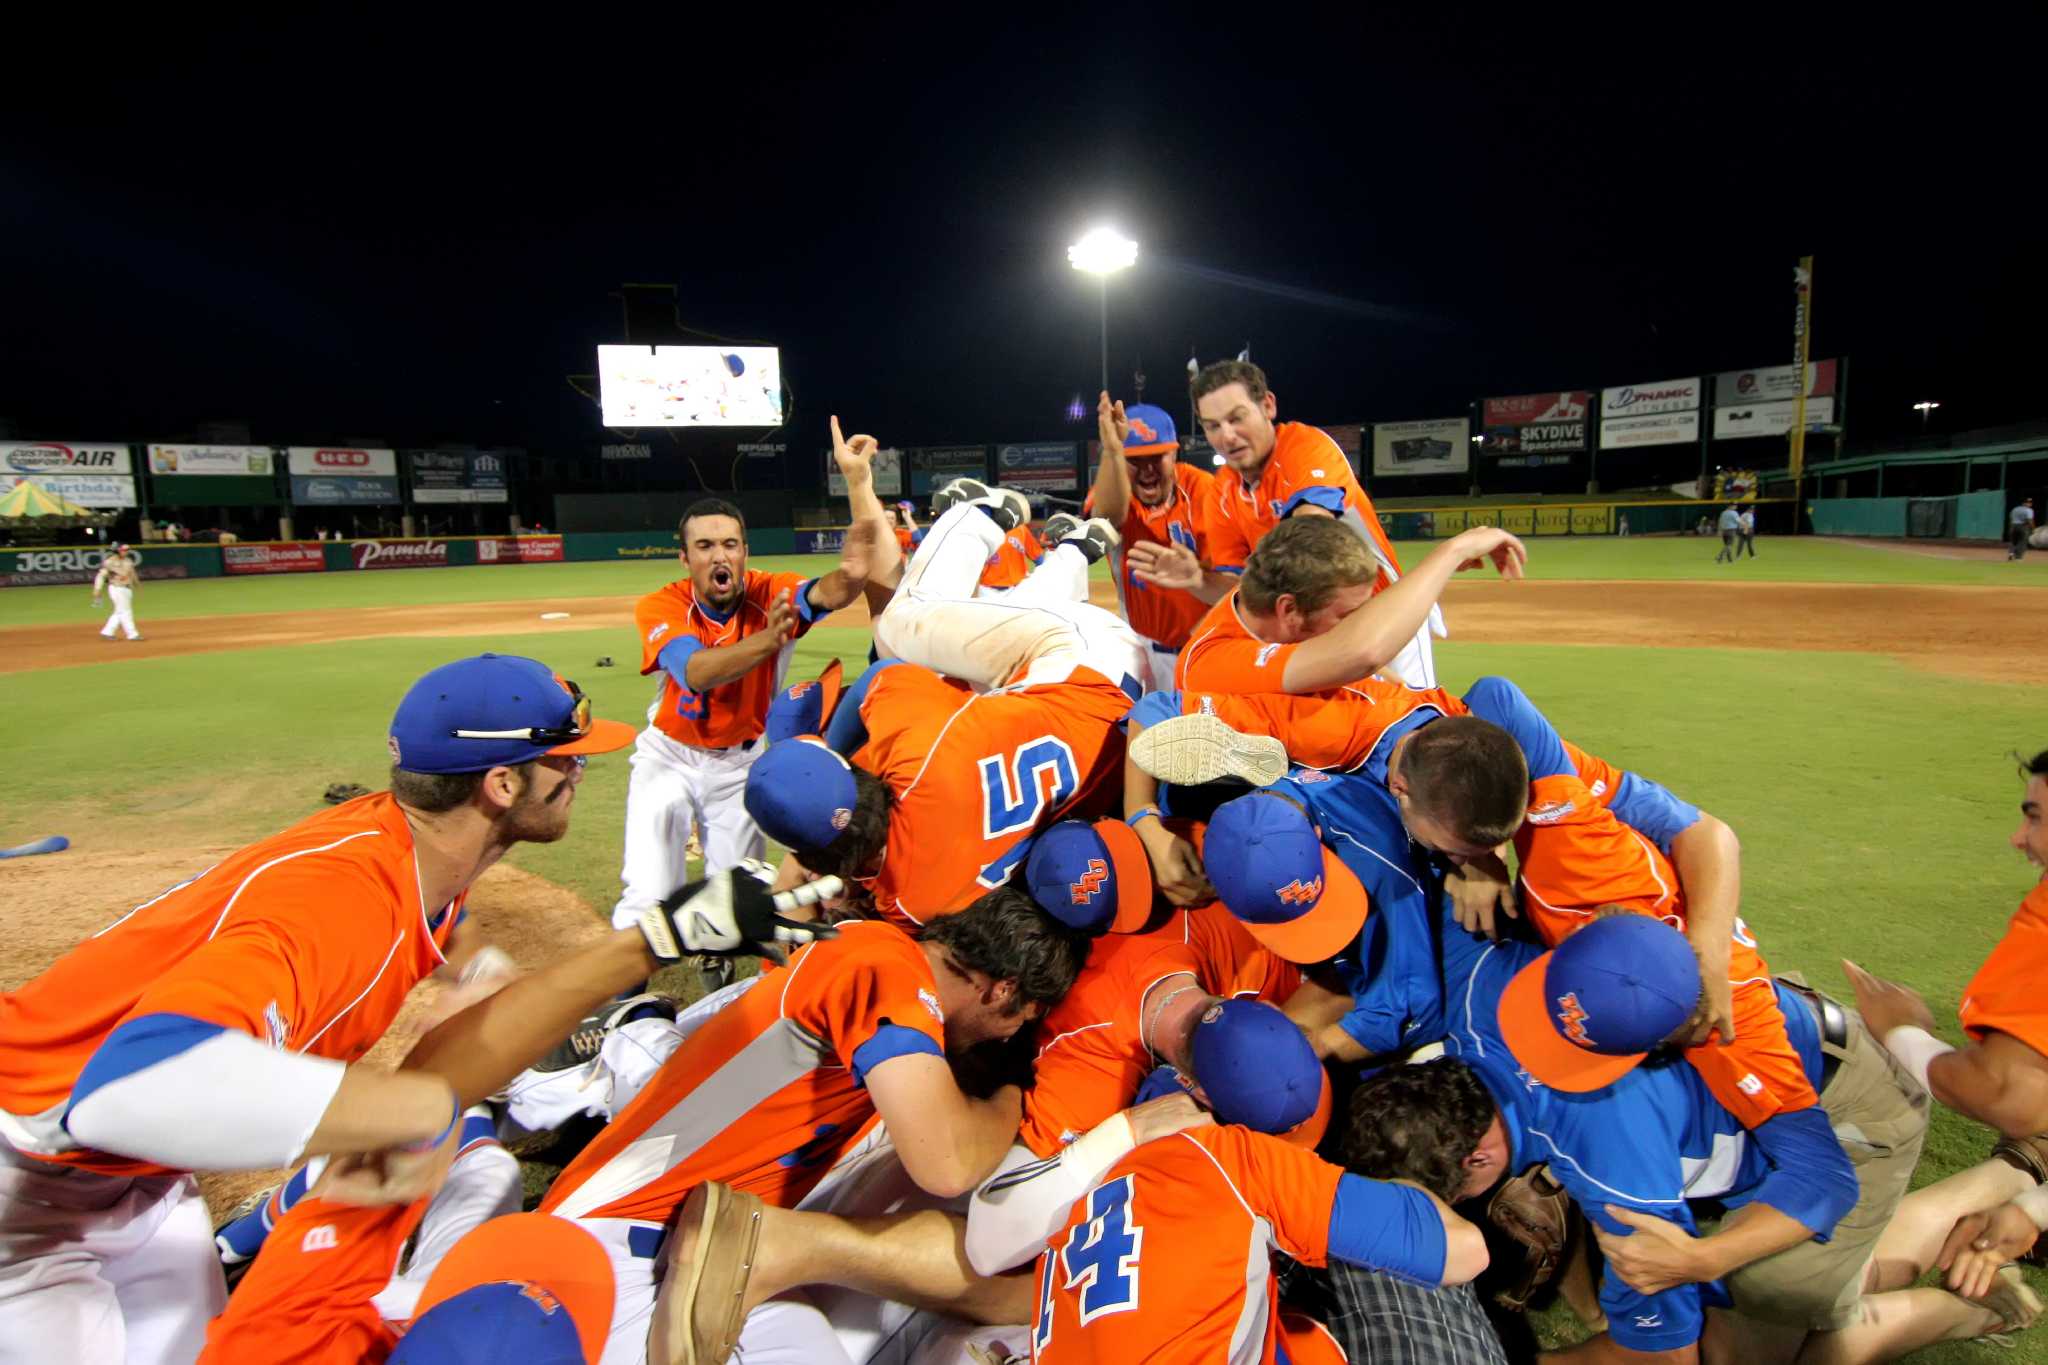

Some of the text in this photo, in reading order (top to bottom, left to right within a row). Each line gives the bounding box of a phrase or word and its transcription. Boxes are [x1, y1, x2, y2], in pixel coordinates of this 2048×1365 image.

[1520, 424, 1584, 440] SKYDIVE
[72, 450, 116, 466] AIR
[351, 540, 448, 569] Pamela
